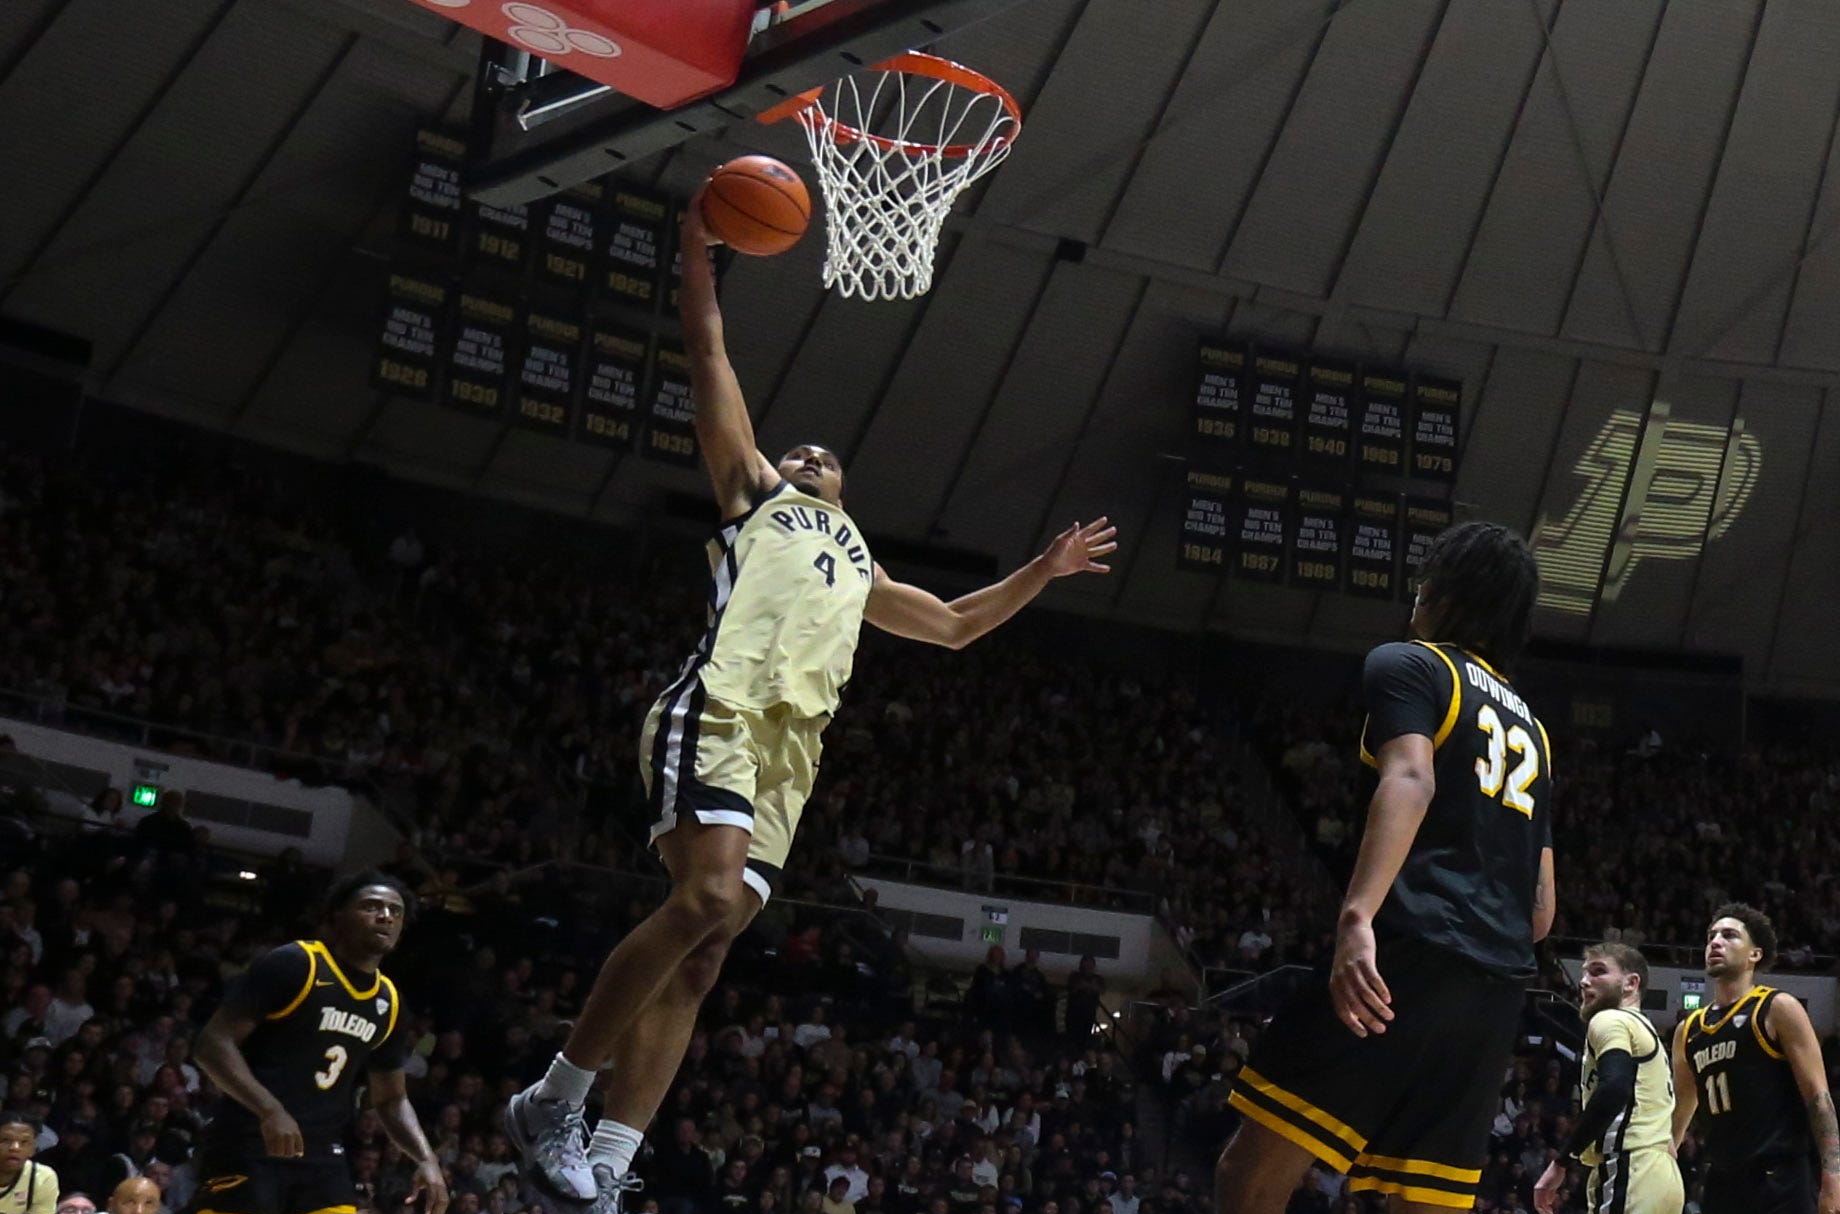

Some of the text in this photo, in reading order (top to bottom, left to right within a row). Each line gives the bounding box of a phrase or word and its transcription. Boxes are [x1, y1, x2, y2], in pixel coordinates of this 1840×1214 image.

[814, 551, 836, 588] 4
[1474, 704, 1539, 820] 32
[319, 1006, 376, 1042] TOLEDO
[314, 1045, 348, 1090] 3
[1693, 1040, 1736, 1074] TOLEDO
[1705, 1072, 1732, 1115] 11
